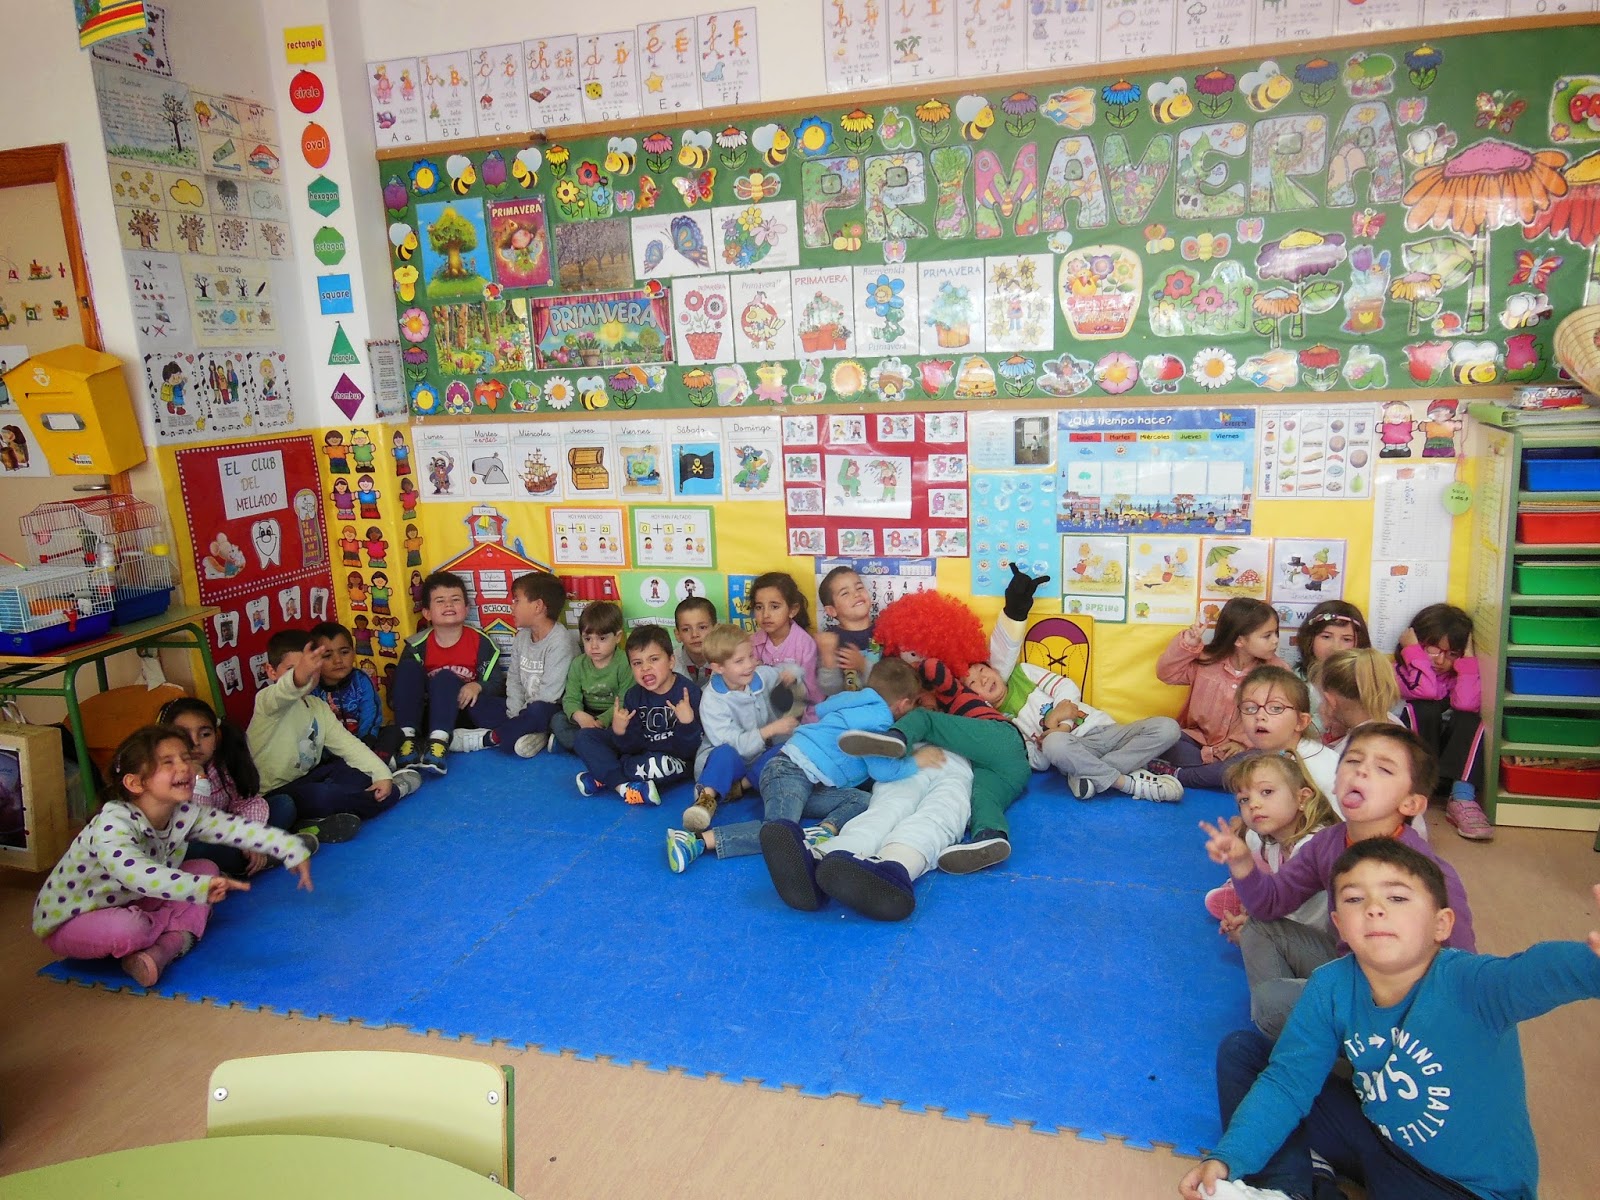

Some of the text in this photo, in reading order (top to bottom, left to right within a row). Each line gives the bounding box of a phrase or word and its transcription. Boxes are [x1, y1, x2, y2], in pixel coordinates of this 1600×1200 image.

[286, 38, 322, 50] rectangle
[294, 86, 320, 99] circle
[305, 136, 326, 150] oval
[801, 100, 1404, 248] PRIMAVERA
[308, 190, 338, 201] hexagon
[491, 203, 542, 218] PRIMAVERA
[315, 240, 344, 252] octagon
[923, 265, 981, 279] PRIMAVERA
[794, 274, 848, 286] PRIMAVERA
[321, 288, 350, 300] square
[549, 301, 659, 336] PRIMAVERA
[333, 390, 362, 401] rhombus
[1097, 415, 1135, 428] tiempo
[1137, 414, 1173, 425] hace?
[474, 429, 498, 438] Martes
[569, 426, 596, 434] Jueves
[620, 426, 652, 435] Viernes
[733, 423, 772, 435] Domingo
[1216, 432, 1240, 440] Viernes
[224, 455, 276, 477] EL CLUB
[240, 475, 260, 491] DEL
[236, 492, 278, 512] MELLADO
[872, 580, 877, 590] 2
[888, 580, 892, 590] 3
[872, 592, 876, 600] 9
[1397, 1086, 1451, 1147] BATTLE
